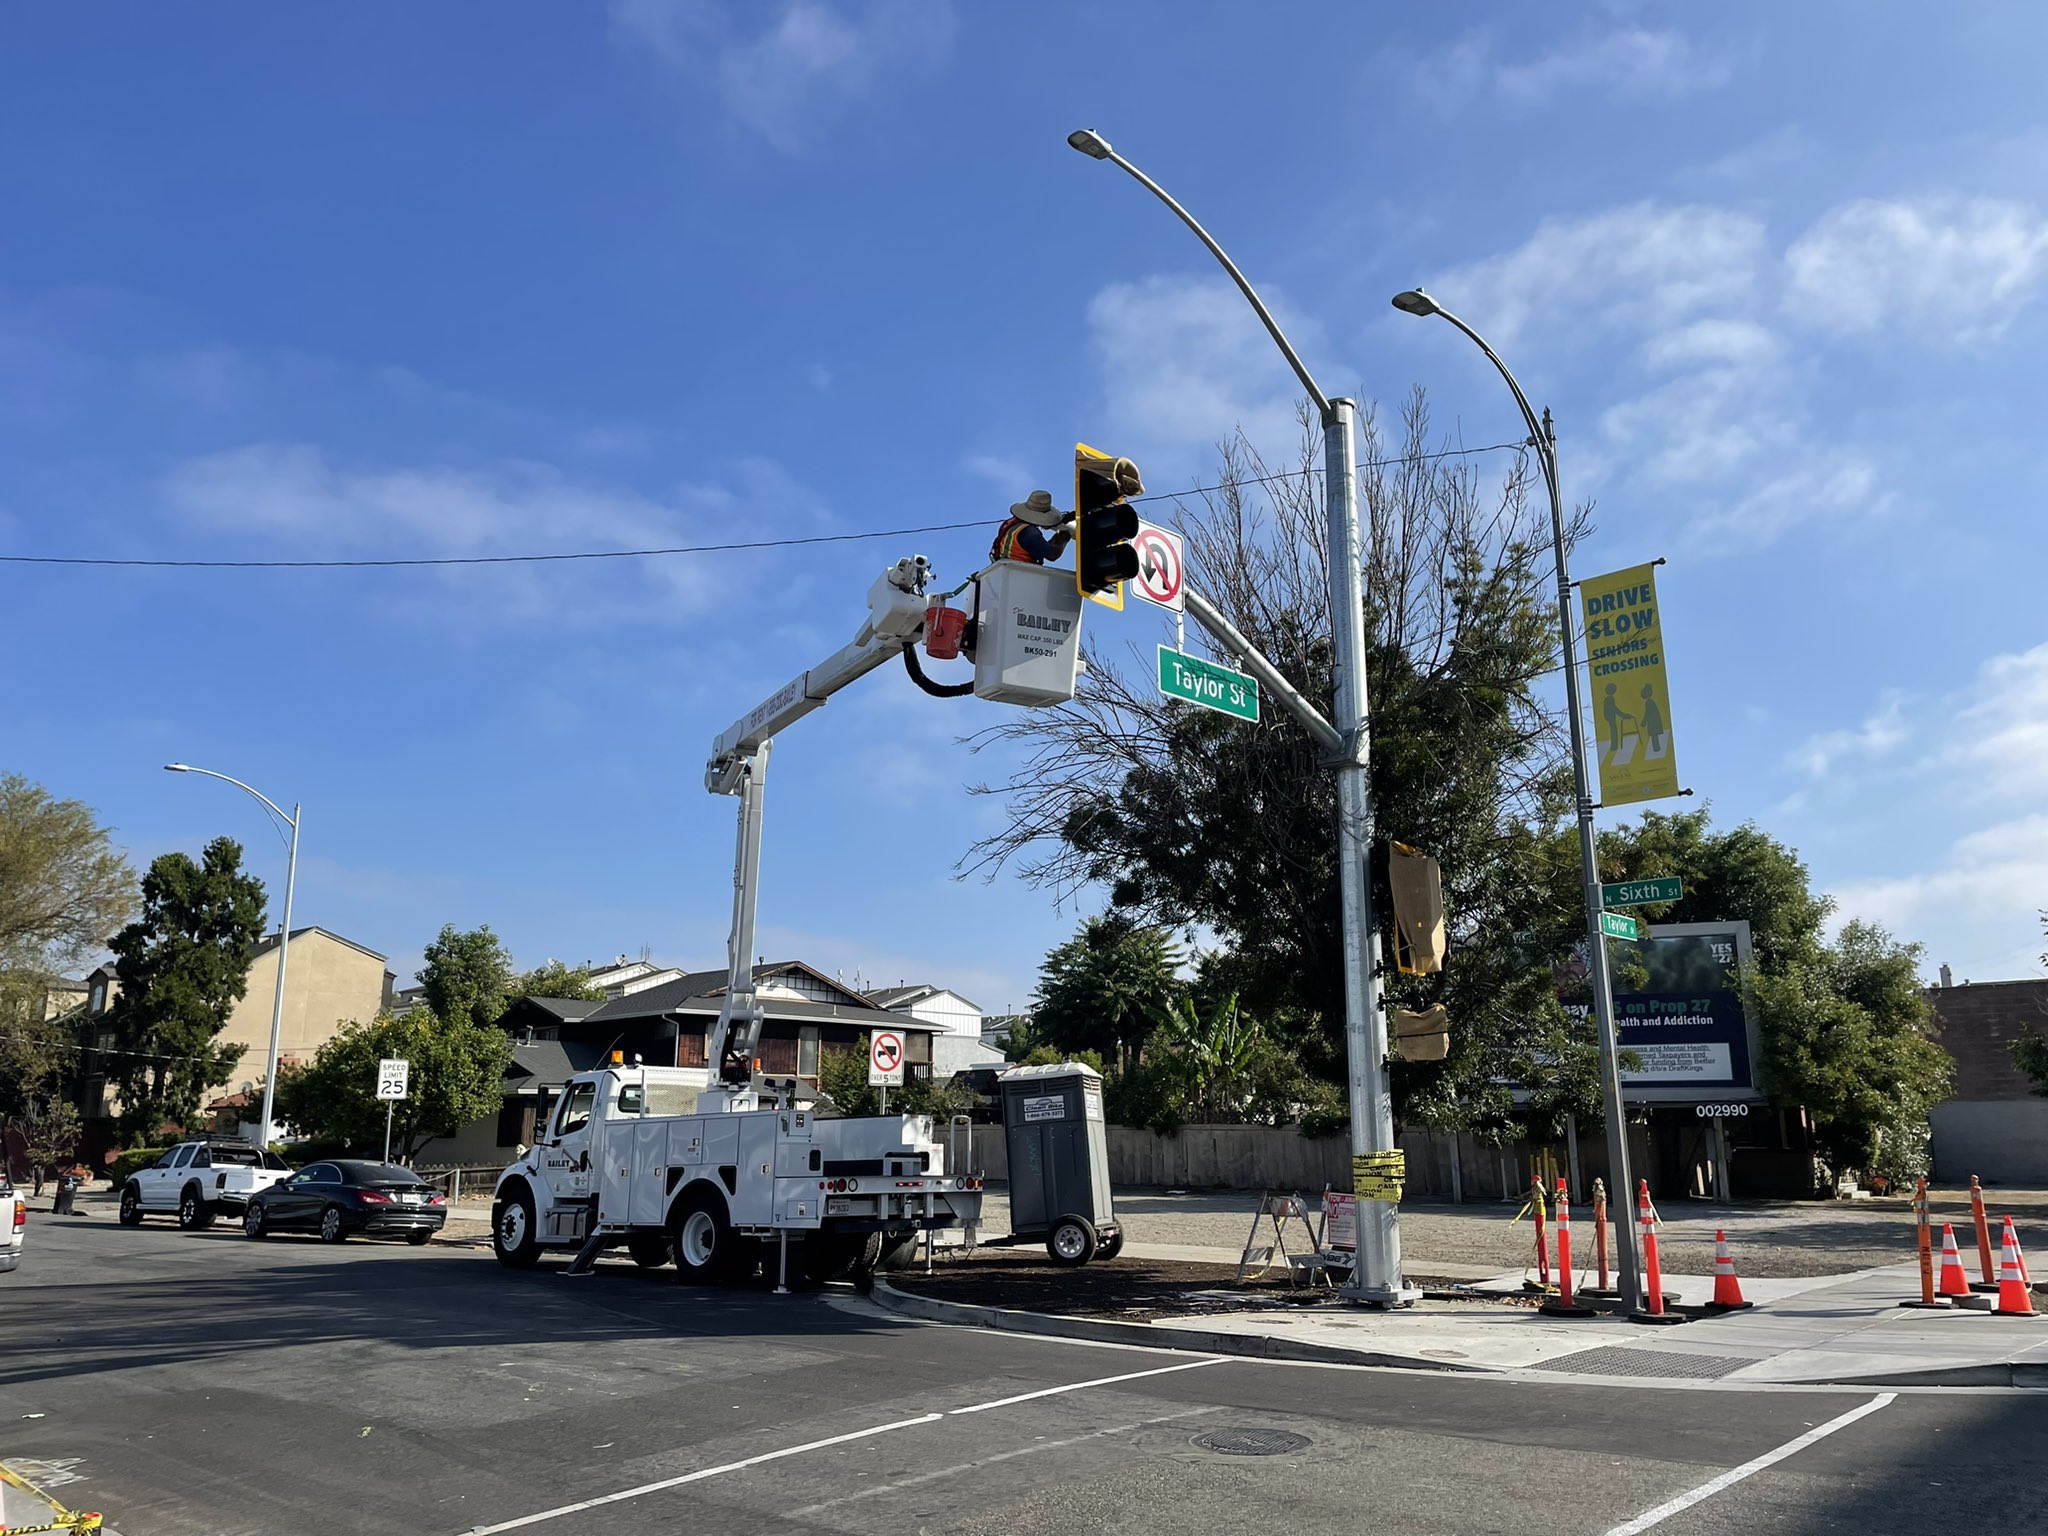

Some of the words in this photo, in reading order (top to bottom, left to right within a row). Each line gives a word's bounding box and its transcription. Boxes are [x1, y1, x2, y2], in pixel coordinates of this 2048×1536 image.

[1587, 584, 1651, 616] DRIVE
[1016, 612, 1071, 633] BAILEY
[1590, 608, 1654, 639] SLOW
[1024, 646, 1057, 658] BK50-291
[1592, 638, 1648, 659] SENIORS
[1594, 653, 1659, 677] CROSSING
[1172, 661, 1225, 700] Taylor
[1229, 683, 1246, 708] St
[1605, 895, 1612, 903] N
[1619, 883, 1660, 901] Sixth
[1668, 888, 1678, 896] St
[1606, 915, 1628, 934] Taylor
[1710, 943, 1732, 954] YES
[1626, 1003, 1645, 1014] on
[1649, 1000, 1687, 1016] Prop
[1690, 999, 1711, 1013] 27
[1614, 1016, 1640, 1027] ealth
[1642, 1016, 1661, 1026] and
[1663, 1014, 1713, 1026] Addiction
[382, 1063, 406, 1071] SPEED
[384, 1071, 403, 1079] LIMIT
[883, 1074, 889, 1083] 5
[890, 1074, 902, 1082] TONS
[381, 1080, 404, 1094] 25
[1696, 1104, 1748, 1117] 002990
[1359, 1151, 1392, 1161] CAUTION
[1328, 1203, 1338, 1218] NO
